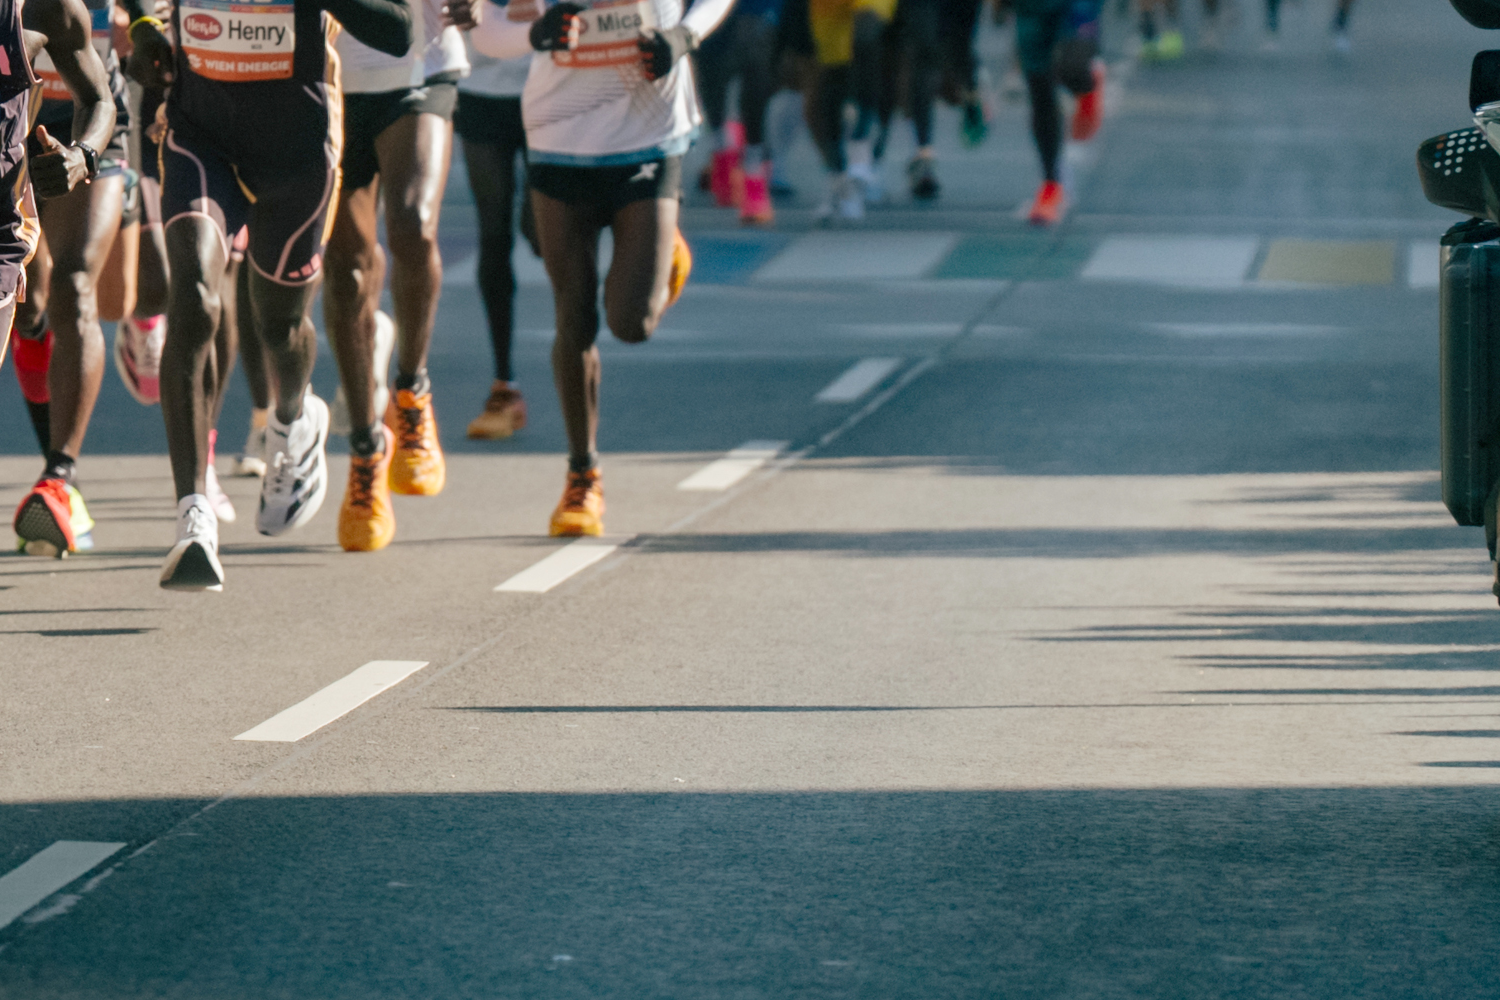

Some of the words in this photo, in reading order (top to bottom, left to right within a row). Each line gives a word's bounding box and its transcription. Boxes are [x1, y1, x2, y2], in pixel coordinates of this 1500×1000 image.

[186, 18, 219, 36] Hervis
[228, 19, 286, 46] Henry
[204, 58, 235, 72] WIEN
[237, 60, 290, 73] ENERGIE
